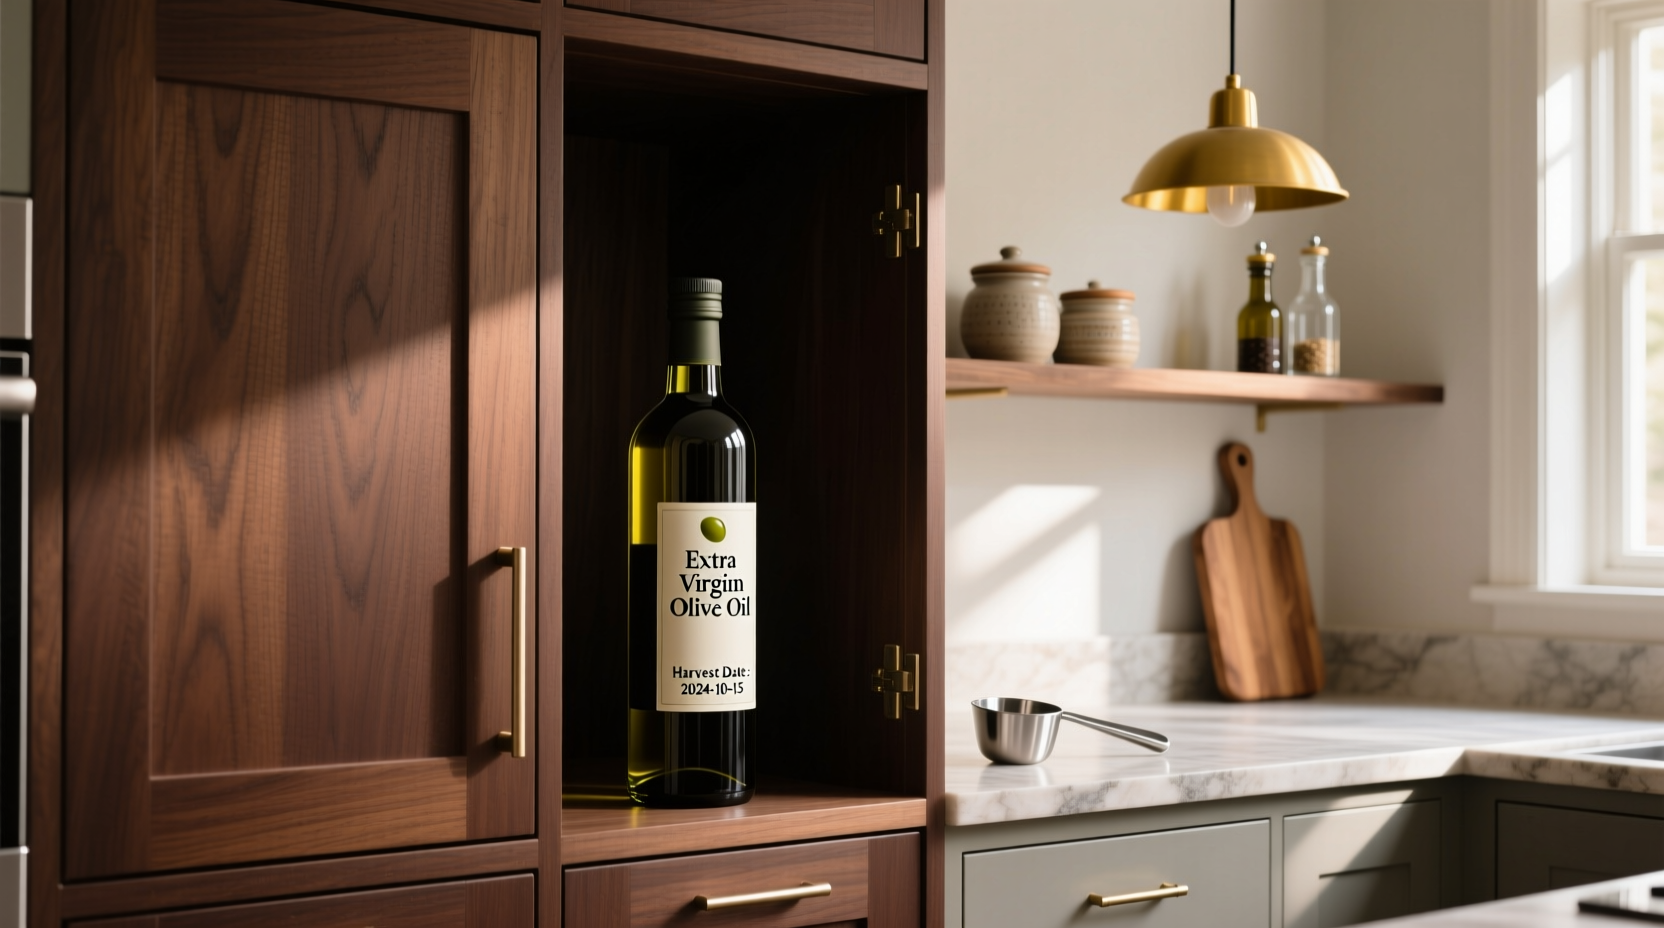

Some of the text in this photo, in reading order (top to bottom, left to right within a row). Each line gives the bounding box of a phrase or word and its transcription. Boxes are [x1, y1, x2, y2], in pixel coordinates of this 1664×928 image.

[685, 549, 737, 570] Extra
[679, 573, 744, 600] Virgin
[669, 596, 750, 618] Olive Oil
[672, 666, 719, 679] Harvest
[680, 682, 744, 696] 2024-10-15
